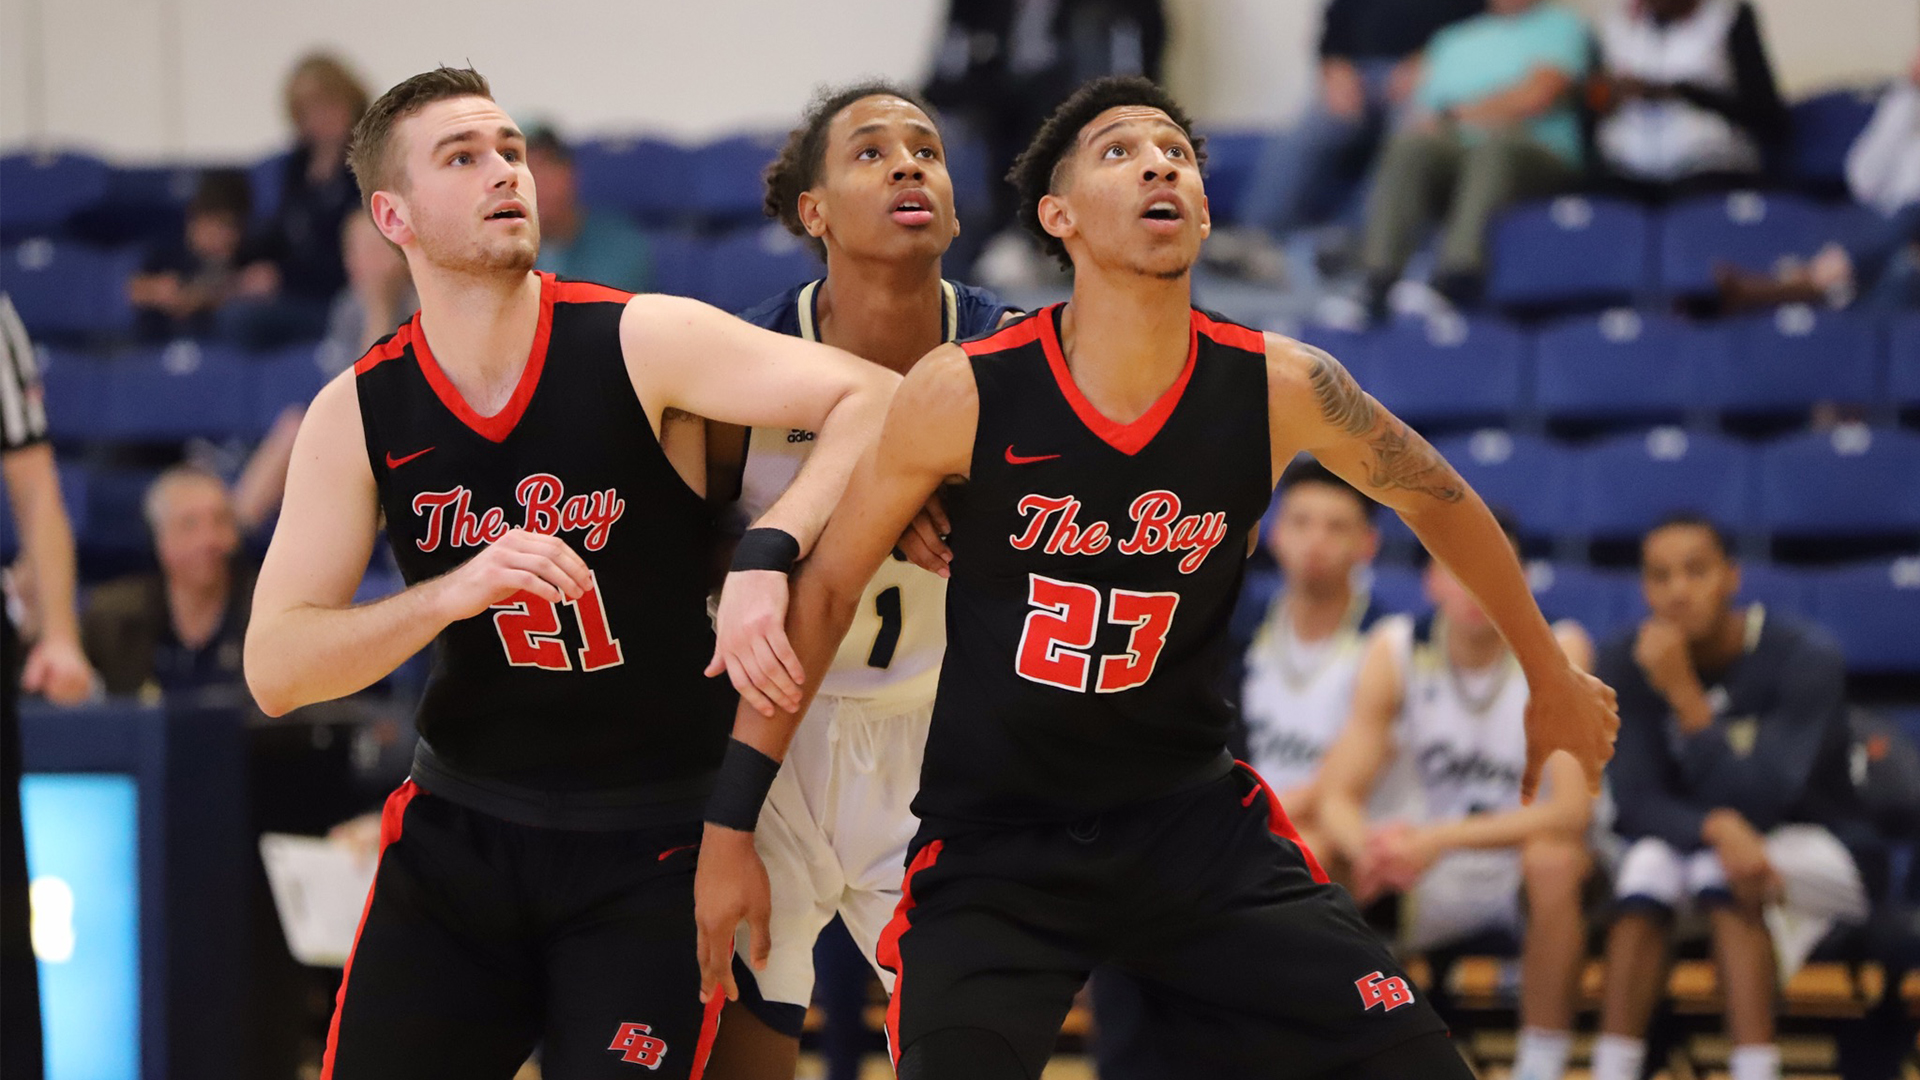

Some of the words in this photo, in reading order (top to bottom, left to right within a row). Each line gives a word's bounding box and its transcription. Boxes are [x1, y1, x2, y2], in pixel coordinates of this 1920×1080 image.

[412, 485, 509, 552] The
[514, 473, 625, 551] Bay
[1009, 493, 1112, 556] The
[1118, 489, 1228, 574] Bay
[489, 569, 624, 672] 21
[866, 585, 903, 669] 1
[1015, 572, 1180, 693] 23
[1354, 970, 1415, 1012] EB
[607, 1022, 668, 1070] EB
